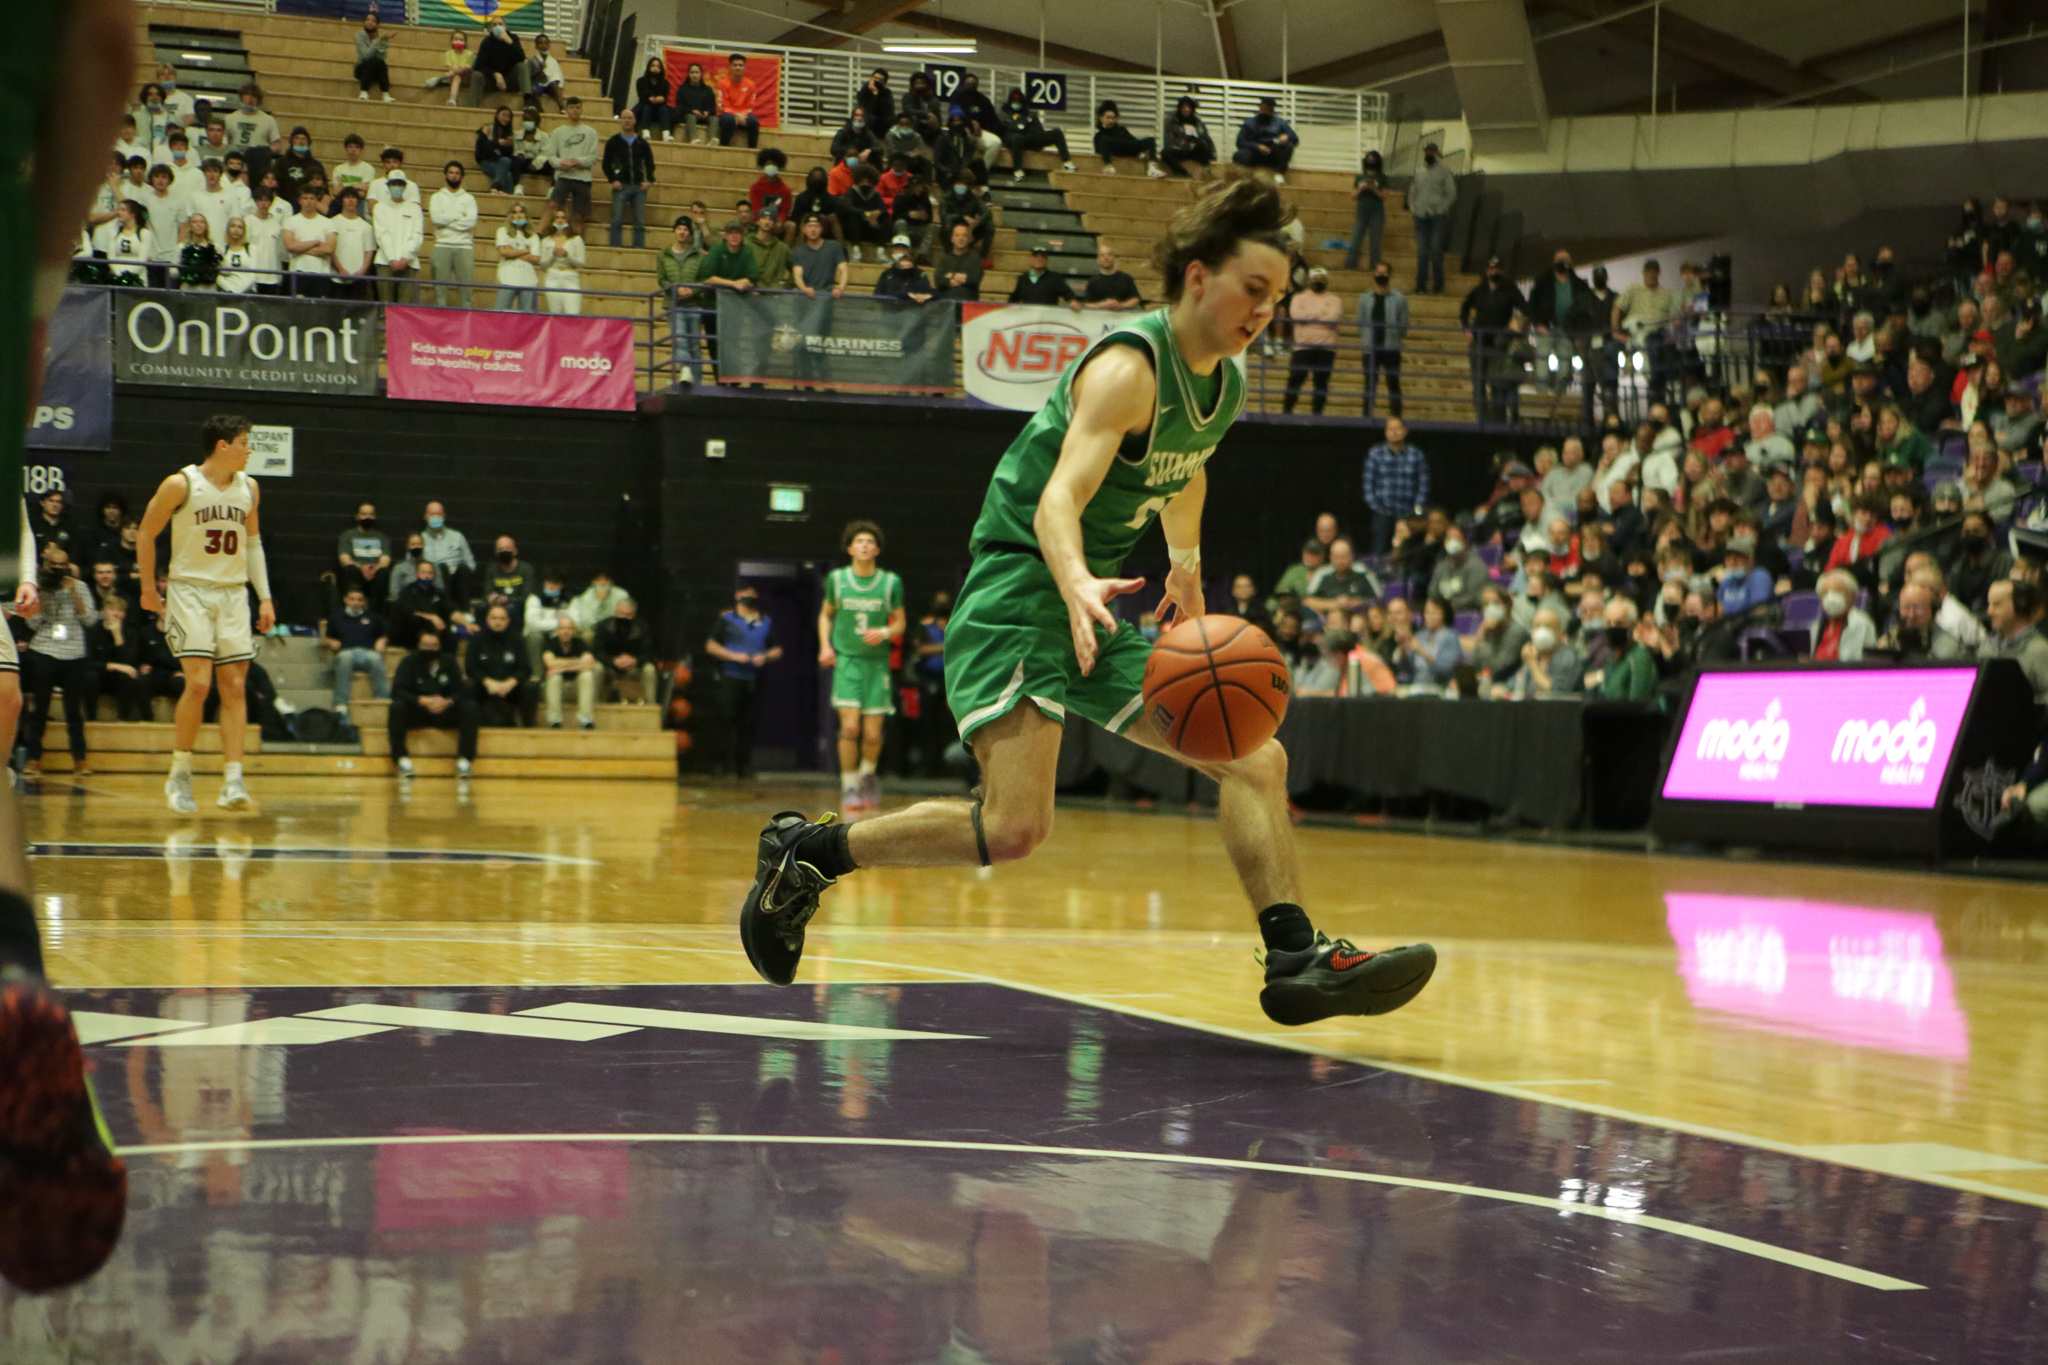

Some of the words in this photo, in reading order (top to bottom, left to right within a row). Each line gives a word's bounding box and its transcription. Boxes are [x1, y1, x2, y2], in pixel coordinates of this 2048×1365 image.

[932, 69, 961, 97] 19
[1031, 78, 1062, 105] 20
[127, 301, 359, 364] OnPoint
[805, 335, 902, 351] MARINES
[411, 342, 437, 354] Kids
[438, 345, 463, 356] who
[464, 346, 492, 360] play
[493, 350, 524, 361] grow
[411, 356, 435, 366] into
[560, 352, 612, 371] moda
[129, 362, 233, 380] COMMUNITY
[239, 368, 296, 383] CREDIT
[302, 372, 358, 385] UNION
[204, 529, 238, 555] 30
[854, 612, 868, 635] 3
[1697, 697, 1790, 761] moda
[1831, 696, 1937, 764] moda
